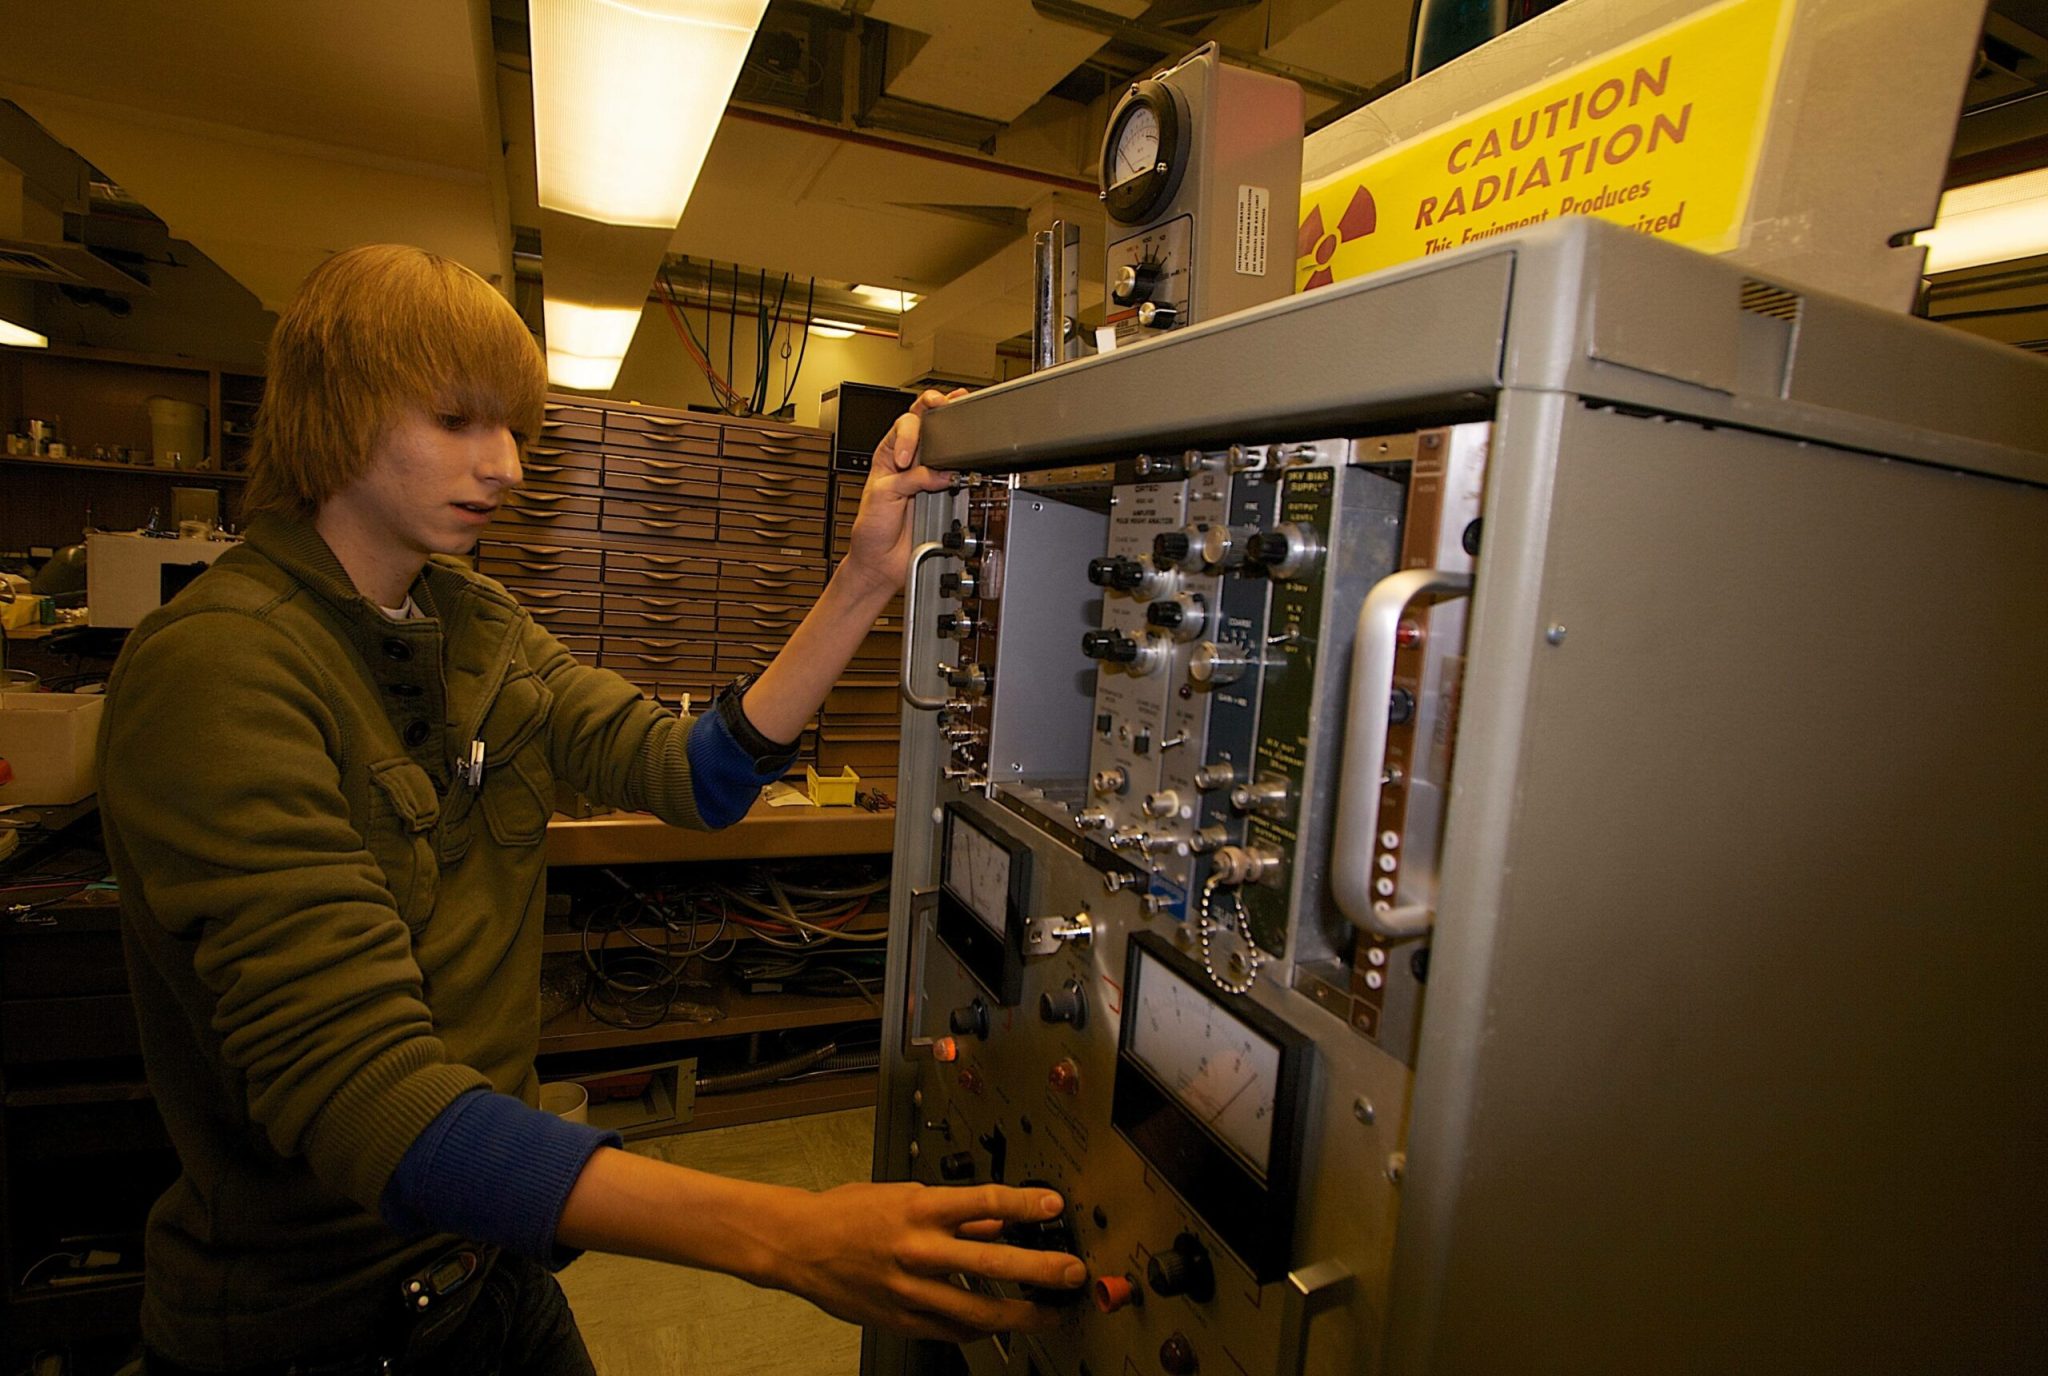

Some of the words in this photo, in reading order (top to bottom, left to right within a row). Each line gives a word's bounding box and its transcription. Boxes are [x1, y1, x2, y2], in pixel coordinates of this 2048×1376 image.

[1446, 56, 1672, 175] CAUTION
[1413, 103, 1693, 231] RADIATION
[1558, 179, 1652, 218] Produces
[1290, 482, 1323, 492] SUPPLY
[1306, 471, 1329, 481] BIAS
